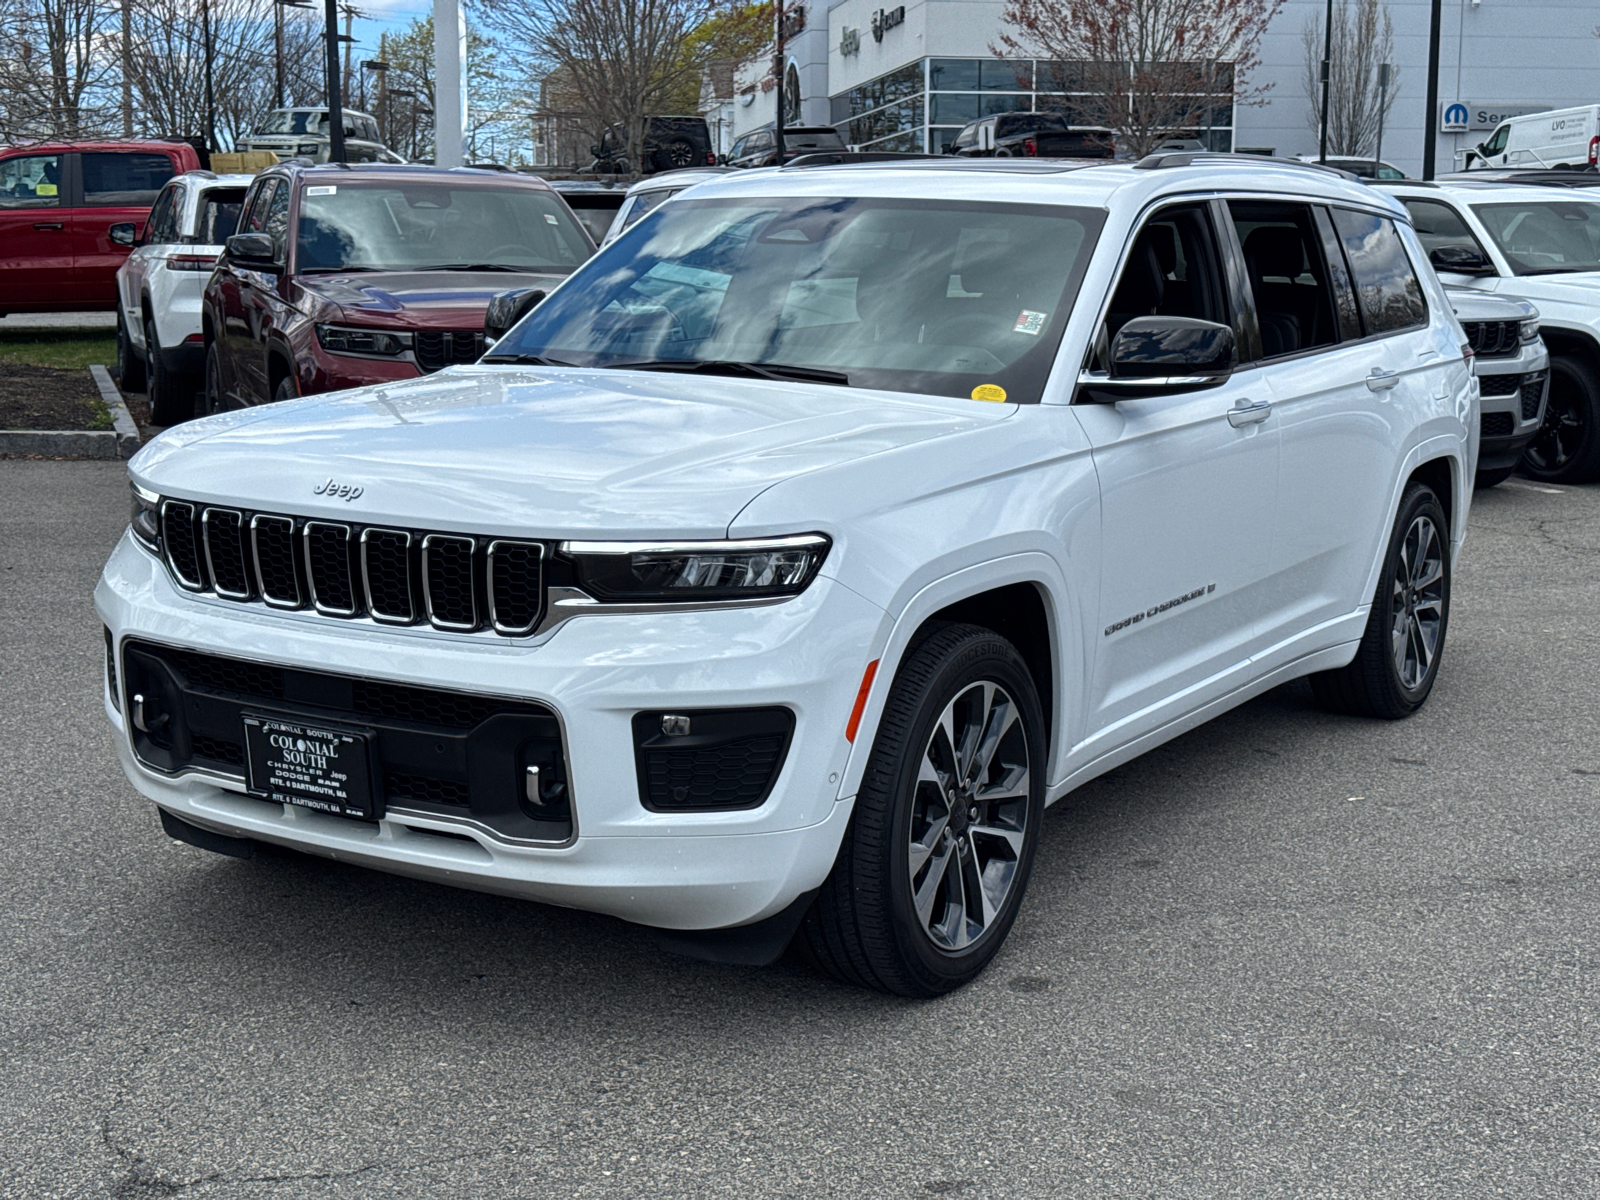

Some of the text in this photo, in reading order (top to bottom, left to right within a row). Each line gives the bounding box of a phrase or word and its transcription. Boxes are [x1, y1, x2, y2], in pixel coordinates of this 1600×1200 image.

[313, 478, 364, 502] Jeep
[266, 722, 303, 735] COLONIAL
[306, 729, 335, 740] SOUTH
[270, 734, 339, 769] COLONIAL SOUTH
[267, 760, 323, 776] CHRYSLER
[275, 769, 311, 782] DODGE
[330, 770, 347, 782] Jeep
[336, 789, 348, 799] MA
[330, 804, 341, 813] MA
